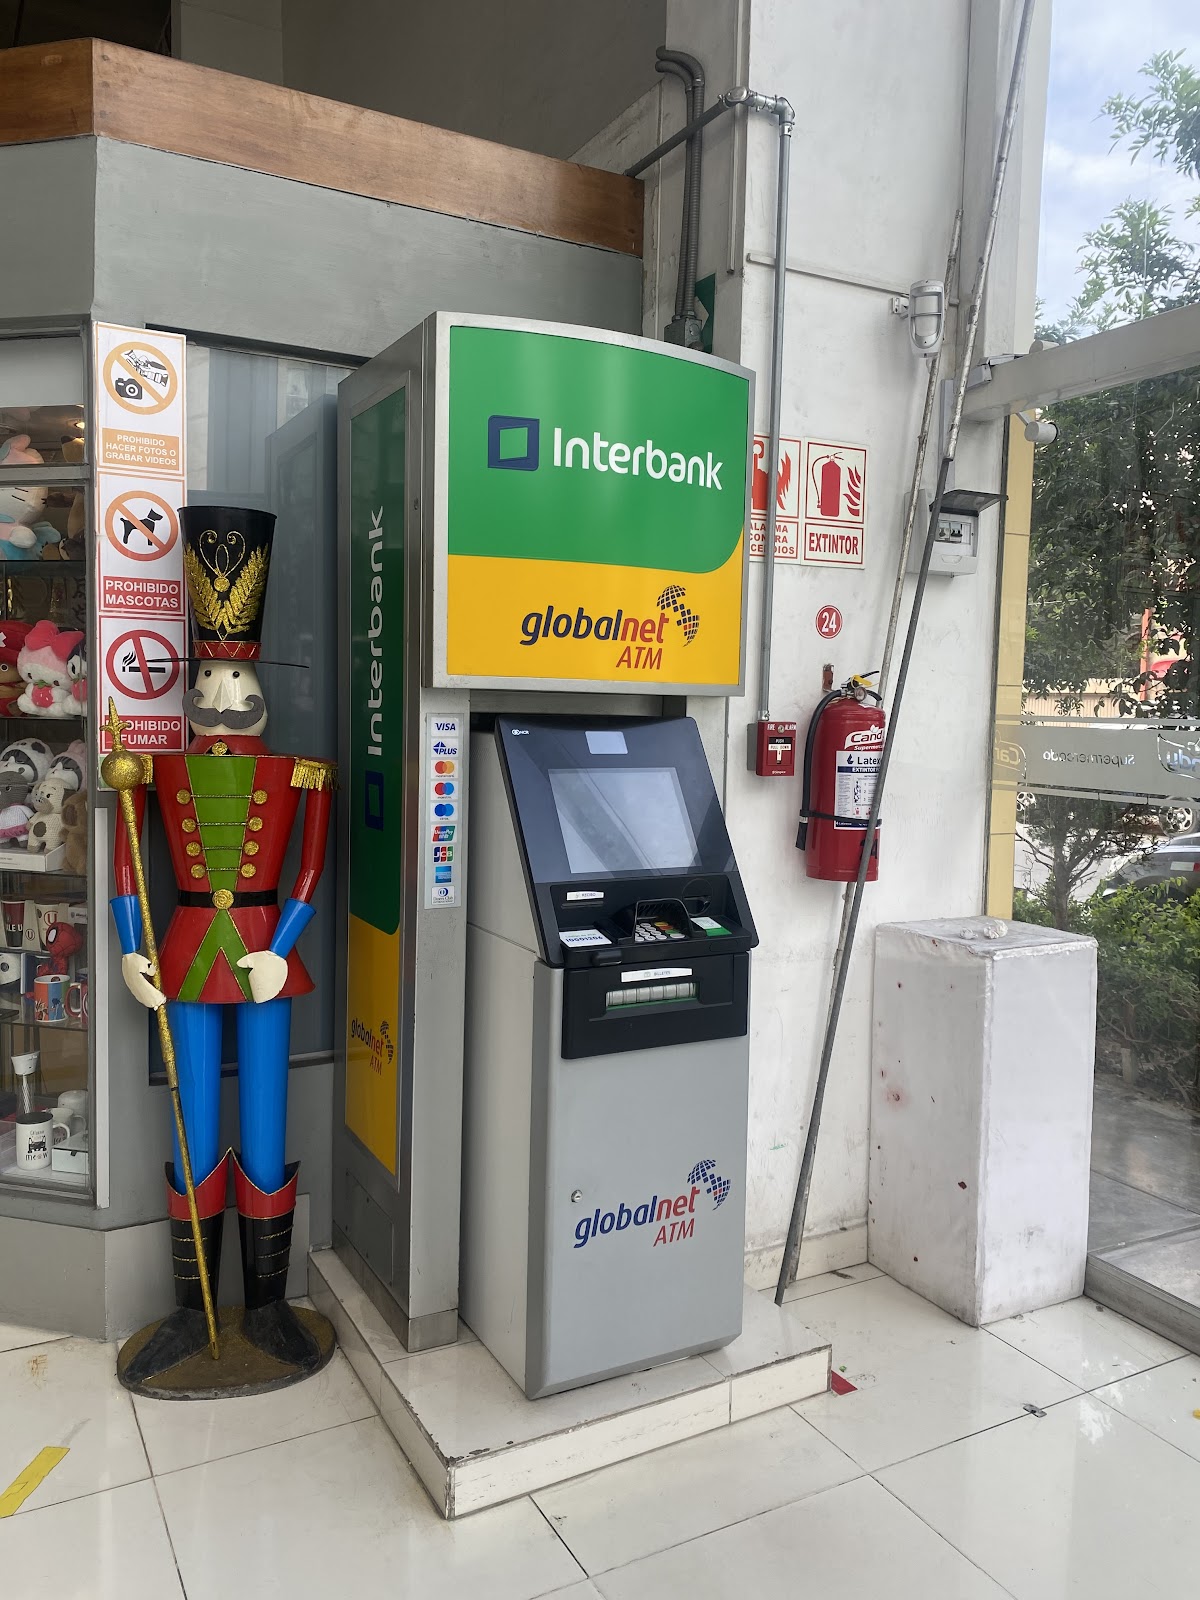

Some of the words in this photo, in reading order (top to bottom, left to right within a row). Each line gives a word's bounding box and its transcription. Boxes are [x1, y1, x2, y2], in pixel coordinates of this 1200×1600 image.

[117, 434, 165, 447] PROHIBIDO
[105, 442, 136, 453] HACER
[138, 445, 167, 456] FOTOS
[169, 449, 176, 457] O
[105, 451, 143, 463] GRABAR
[145, 456, 177, 466] VIDEOS
[553, 427, 723, 491] Interbank
[750, 522, 789, 533] LAMA
[808, 532, 859, 555] EXTINTOR
[105, 579, 179, 595] PROHIBIDO
[105, 594, 179, 609] MASCOTAS
[519, 604, 669, 646] globalnet
[821, 611, 837, 633] 24
[367, 505, 383, 756] Interbank
[615, 645, 663, 670] ATM
[106, 719, 181, 732] OHIBIDO
[434, 722, 456, 731] VISA
[120, 734, 168, 745] FUMAR
[850, 730, 885, 743] Cand
[438, 747, 458, 755] PLUS
[351, 1017, 384, 1058] globalnet
[369, 1055, 383, 1076] ATM
[573, 1186, 700, 1249] globalnet
[652, 1218, 695, 1248] ATM
